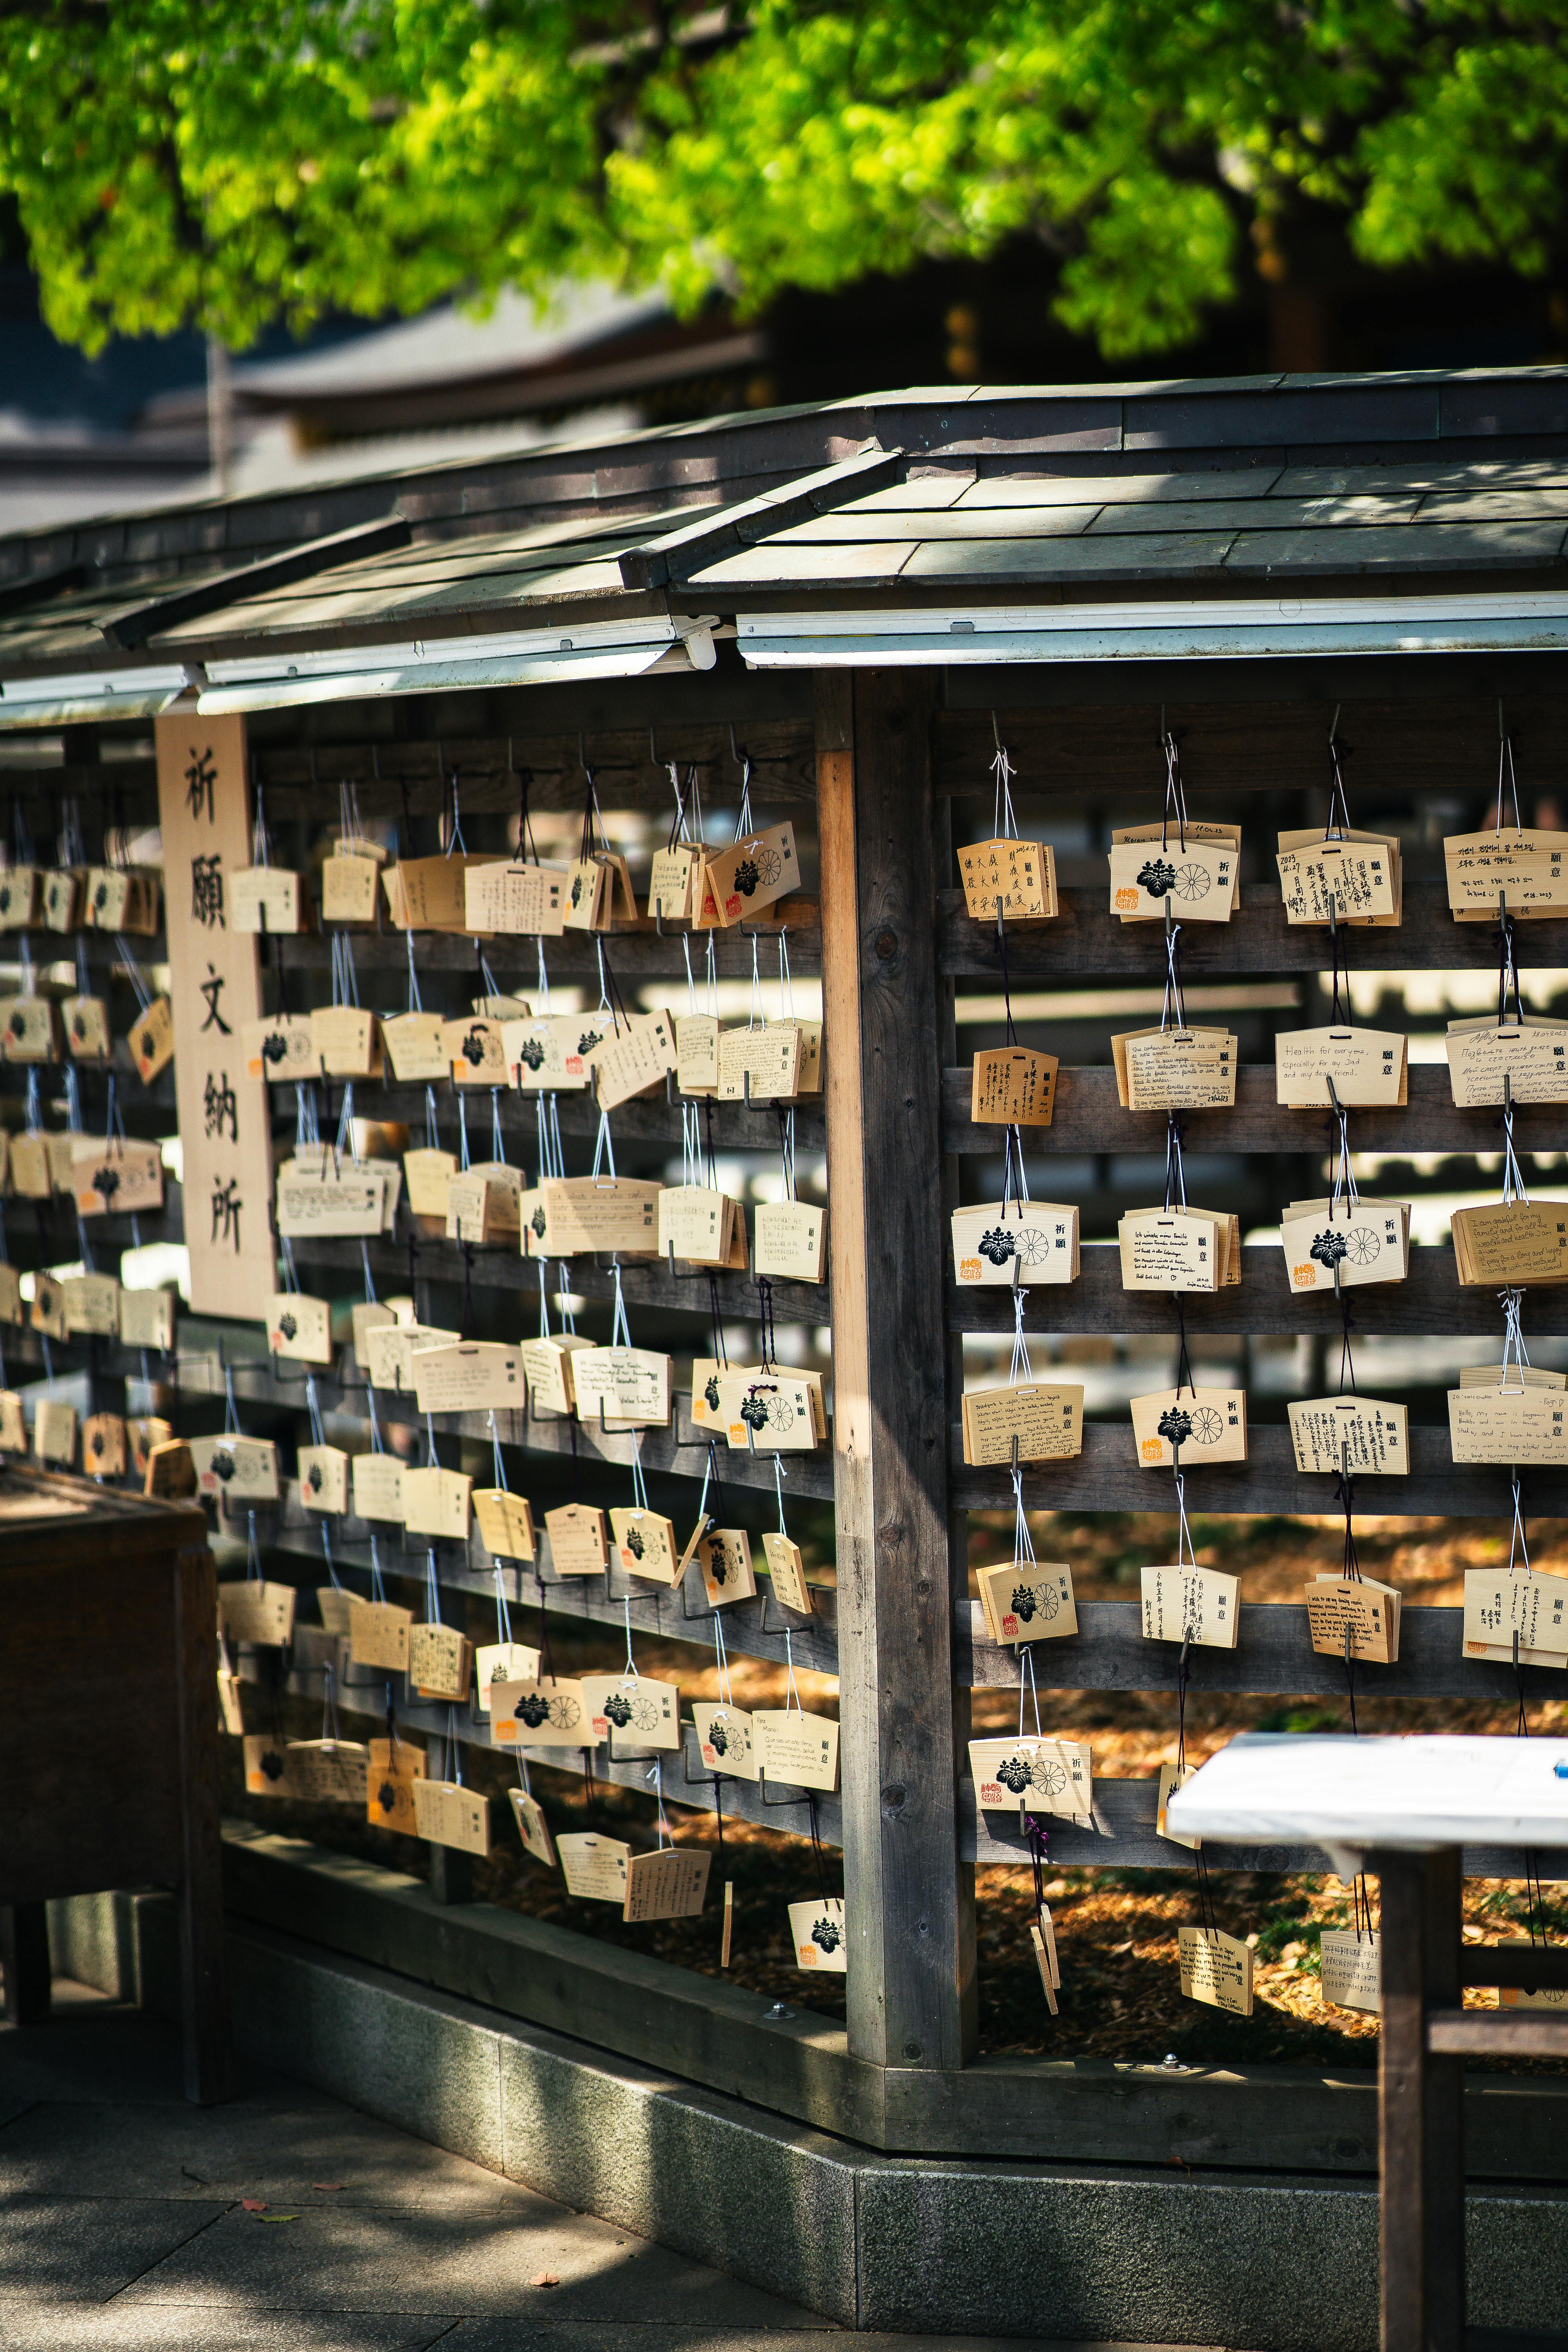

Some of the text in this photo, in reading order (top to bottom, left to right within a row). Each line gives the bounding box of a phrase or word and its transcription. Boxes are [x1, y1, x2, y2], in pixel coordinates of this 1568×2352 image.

[1280, 854, 1296, 865] 2023
[1504, 844, 1510, 853] 잘
[1024, 862, 1034, 886] 願意
[1217, 862, 1230, 887] 祈願
[1370, 860, 1383, 886] 願意
[1550, 853, 1561, 877] 願意
[966, 870, 1000, 889] 發大財
[1356, 860, 1374, 907] 国家試験に
[183, 744, 241, 1256] 祈願文納所
[1285, 1045, 1314, 1056] Health
[1382, 1051, 1393, 1074] 願意
[1553, 1046, 1566, 1071] 願意
[1220, 1052, 1229, 1076] 願意
[1282, 1059, 1315, 1069] especially
[1462, 1067, 1479, 1075] Мой
[1043, 1072, 1050, 1096] 願意
[1384, 1219, 1397, 1245] 祈願
[1470, 1218, 1478, 1227] I
[1493, 1214, 1517, 1229] grateful
[1520, 1213, 1529, 1223] for
[1530, 1214, 1541, 1223] my
[1473, 1228, 1499, 1239] family
[1500, 1225, 1514, 1234] and
[808, 1228, 814, 1250] 願意
[1055, 1224, 1066, 1249] 祈願
[1476, 1238, 1501, 1248] wealth
[1501, 1234, 1514, 1244] and
[1514, 1231, 1534, 1241] health
[1557, 1223, 1568, 1247] 願意
[1198, 1237, 1207, 1261] 願意
[1486, 1259, 1500, 1267] pray
[1517, 1251, 1530, 1261] long
[1532, 1247, 1544, 1256] and
[1545, 1247, 1562, 1256] happy
[1533, 1256, 1557, 1265] beloved
[1533, 1261, 1563, 1272] husband
[795, 1394, 806, 1416] 祈願
[1062, 1405, 1073, 1429] 願意
[1227, 1401, 1239, 1425] 祈願
[1459, 1409, 1473, 1417] Hello,
[1386, 1422, 1398, 1446] 願意
[1552, 1411, 1563, 1436] 願意
[1059, 1577, 1069, 1601] 祈願
[1218, 1595, 1227, 1620] 願意
[1552, 1599, 1564, 1624] 願意
[662, 1697, 671, 1719] 祈願
[743, 1728, 751, 1749] 祈願
[821, 1740, 829, 1764] 願意
[1072, 1758, 1083, 1781] 祈願
